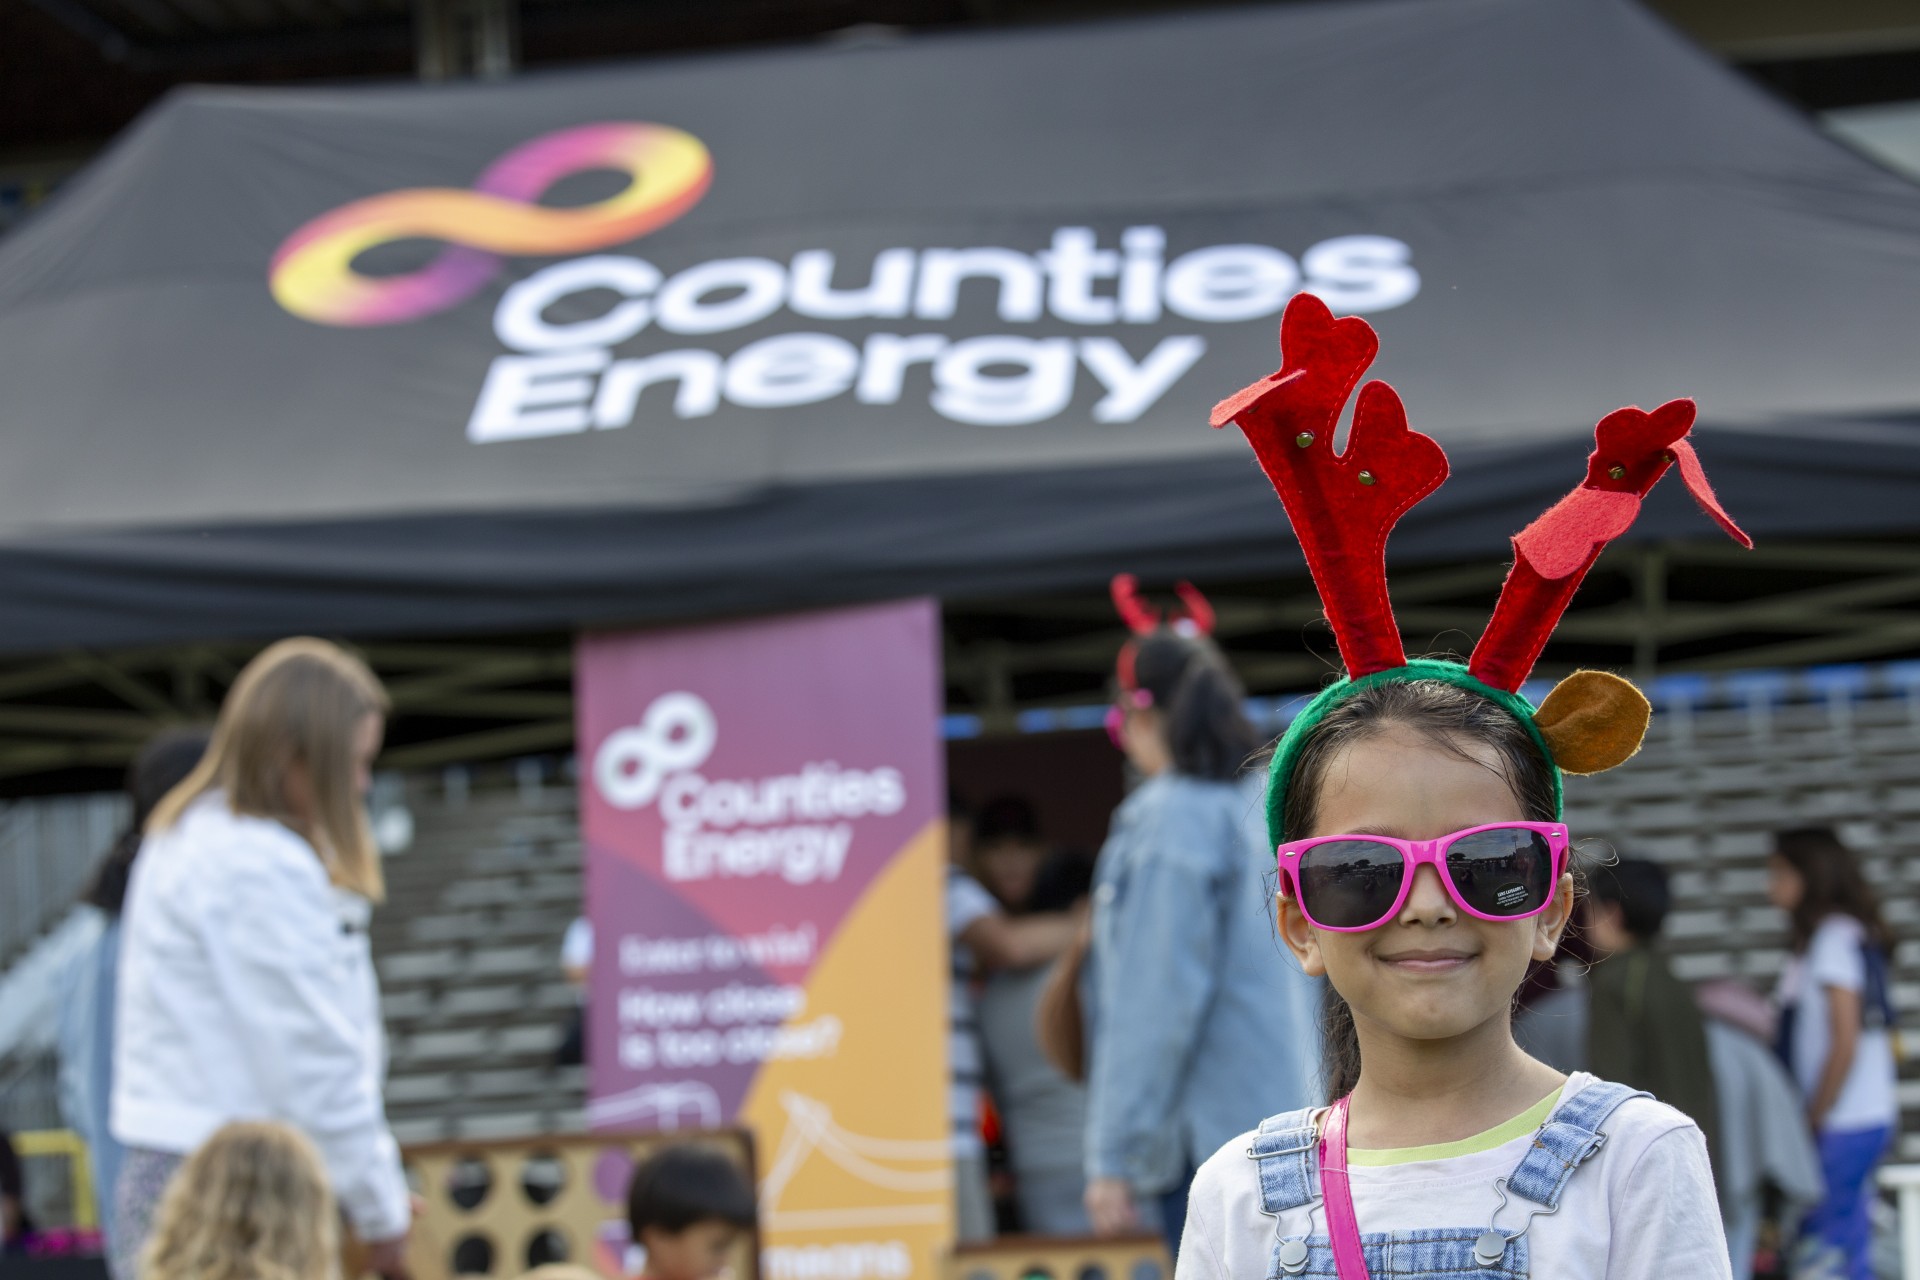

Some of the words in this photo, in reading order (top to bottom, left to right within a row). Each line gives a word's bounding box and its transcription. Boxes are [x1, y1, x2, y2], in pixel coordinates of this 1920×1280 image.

[494, 226, 1420, 352] Counties
[466, 332, 1207, 444] Energy
[660, 761, 905, 828] Counties
[664, 822, 852, 884] Energy
